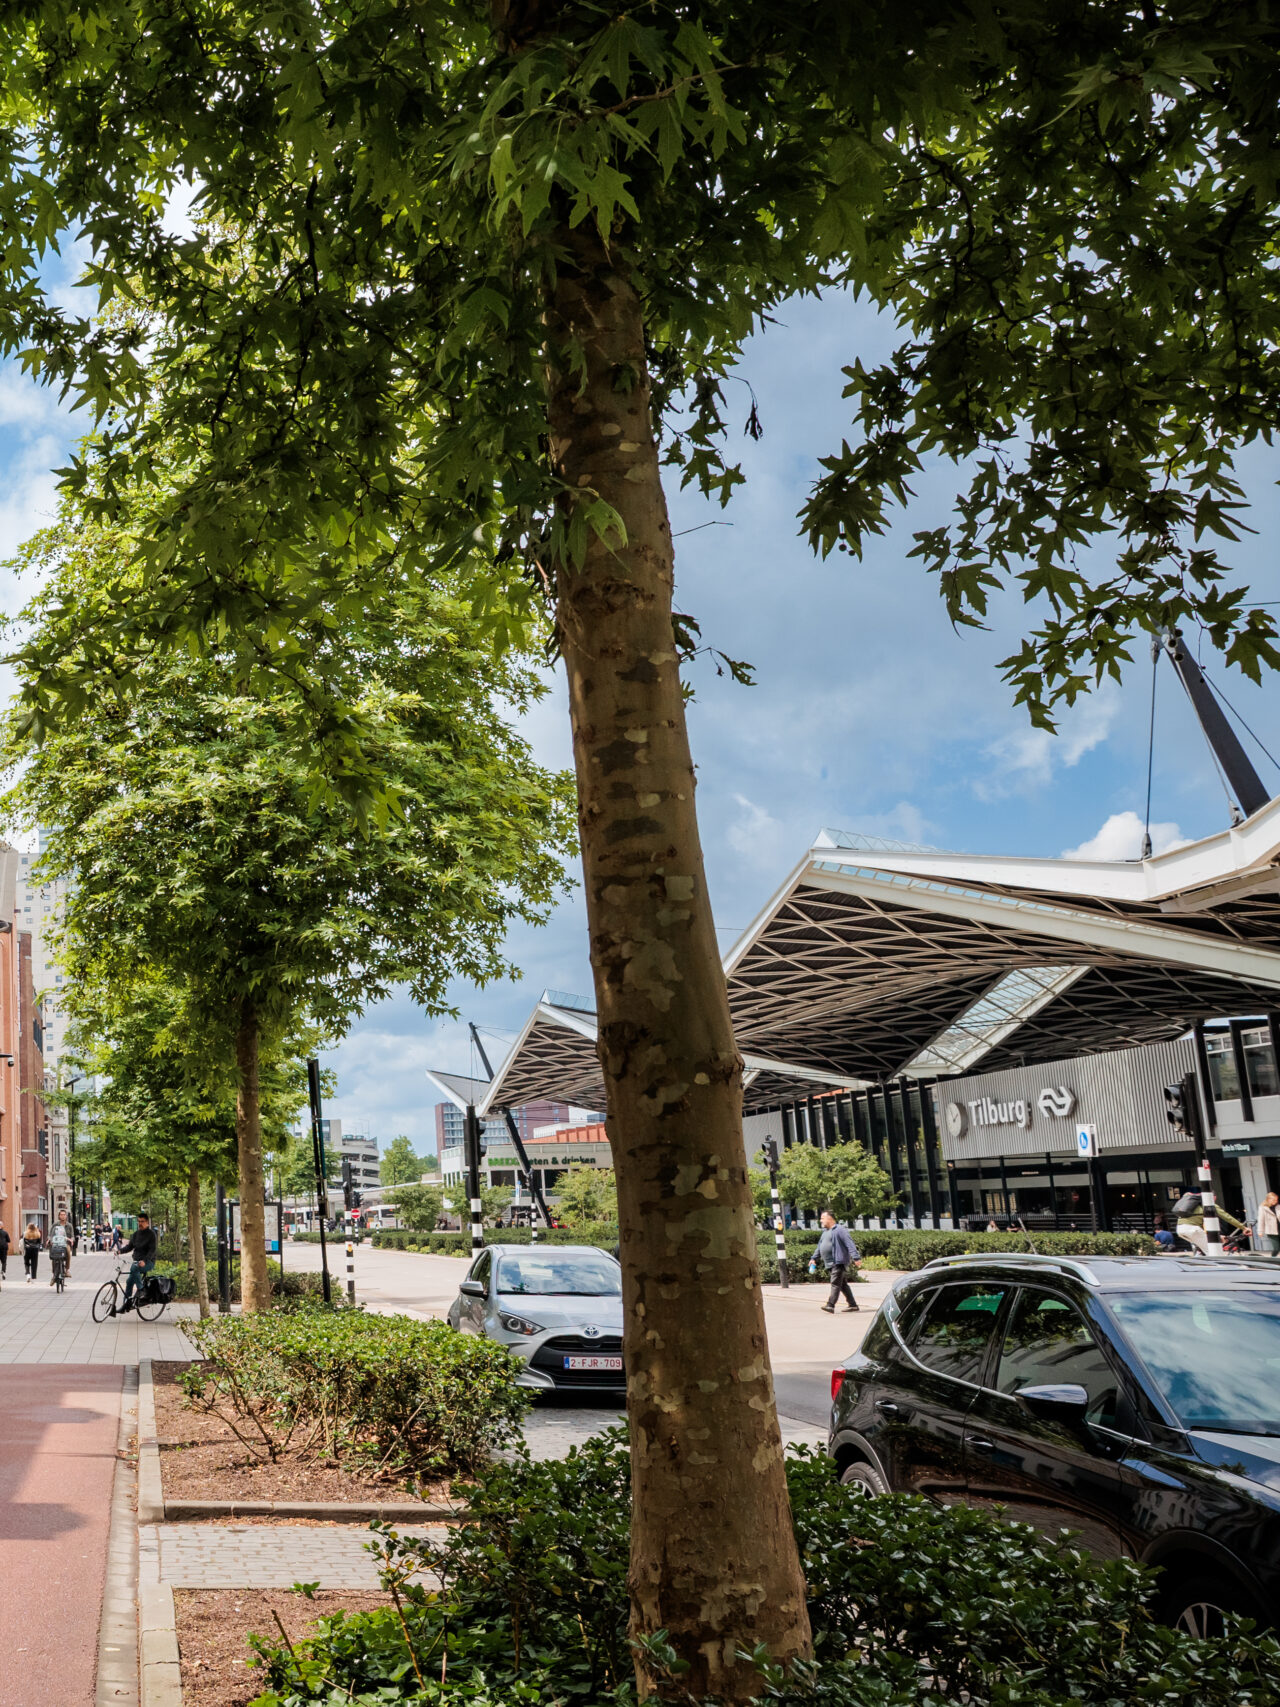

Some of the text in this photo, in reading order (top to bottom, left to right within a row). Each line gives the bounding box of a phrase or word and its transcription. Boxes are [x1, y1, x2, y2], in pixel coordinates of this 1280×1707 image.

[968, 1096, 1028, 1128] Tilburg
[551, 1157, 559, 1165] &
[562, 1155, 597, 1165] drinken
